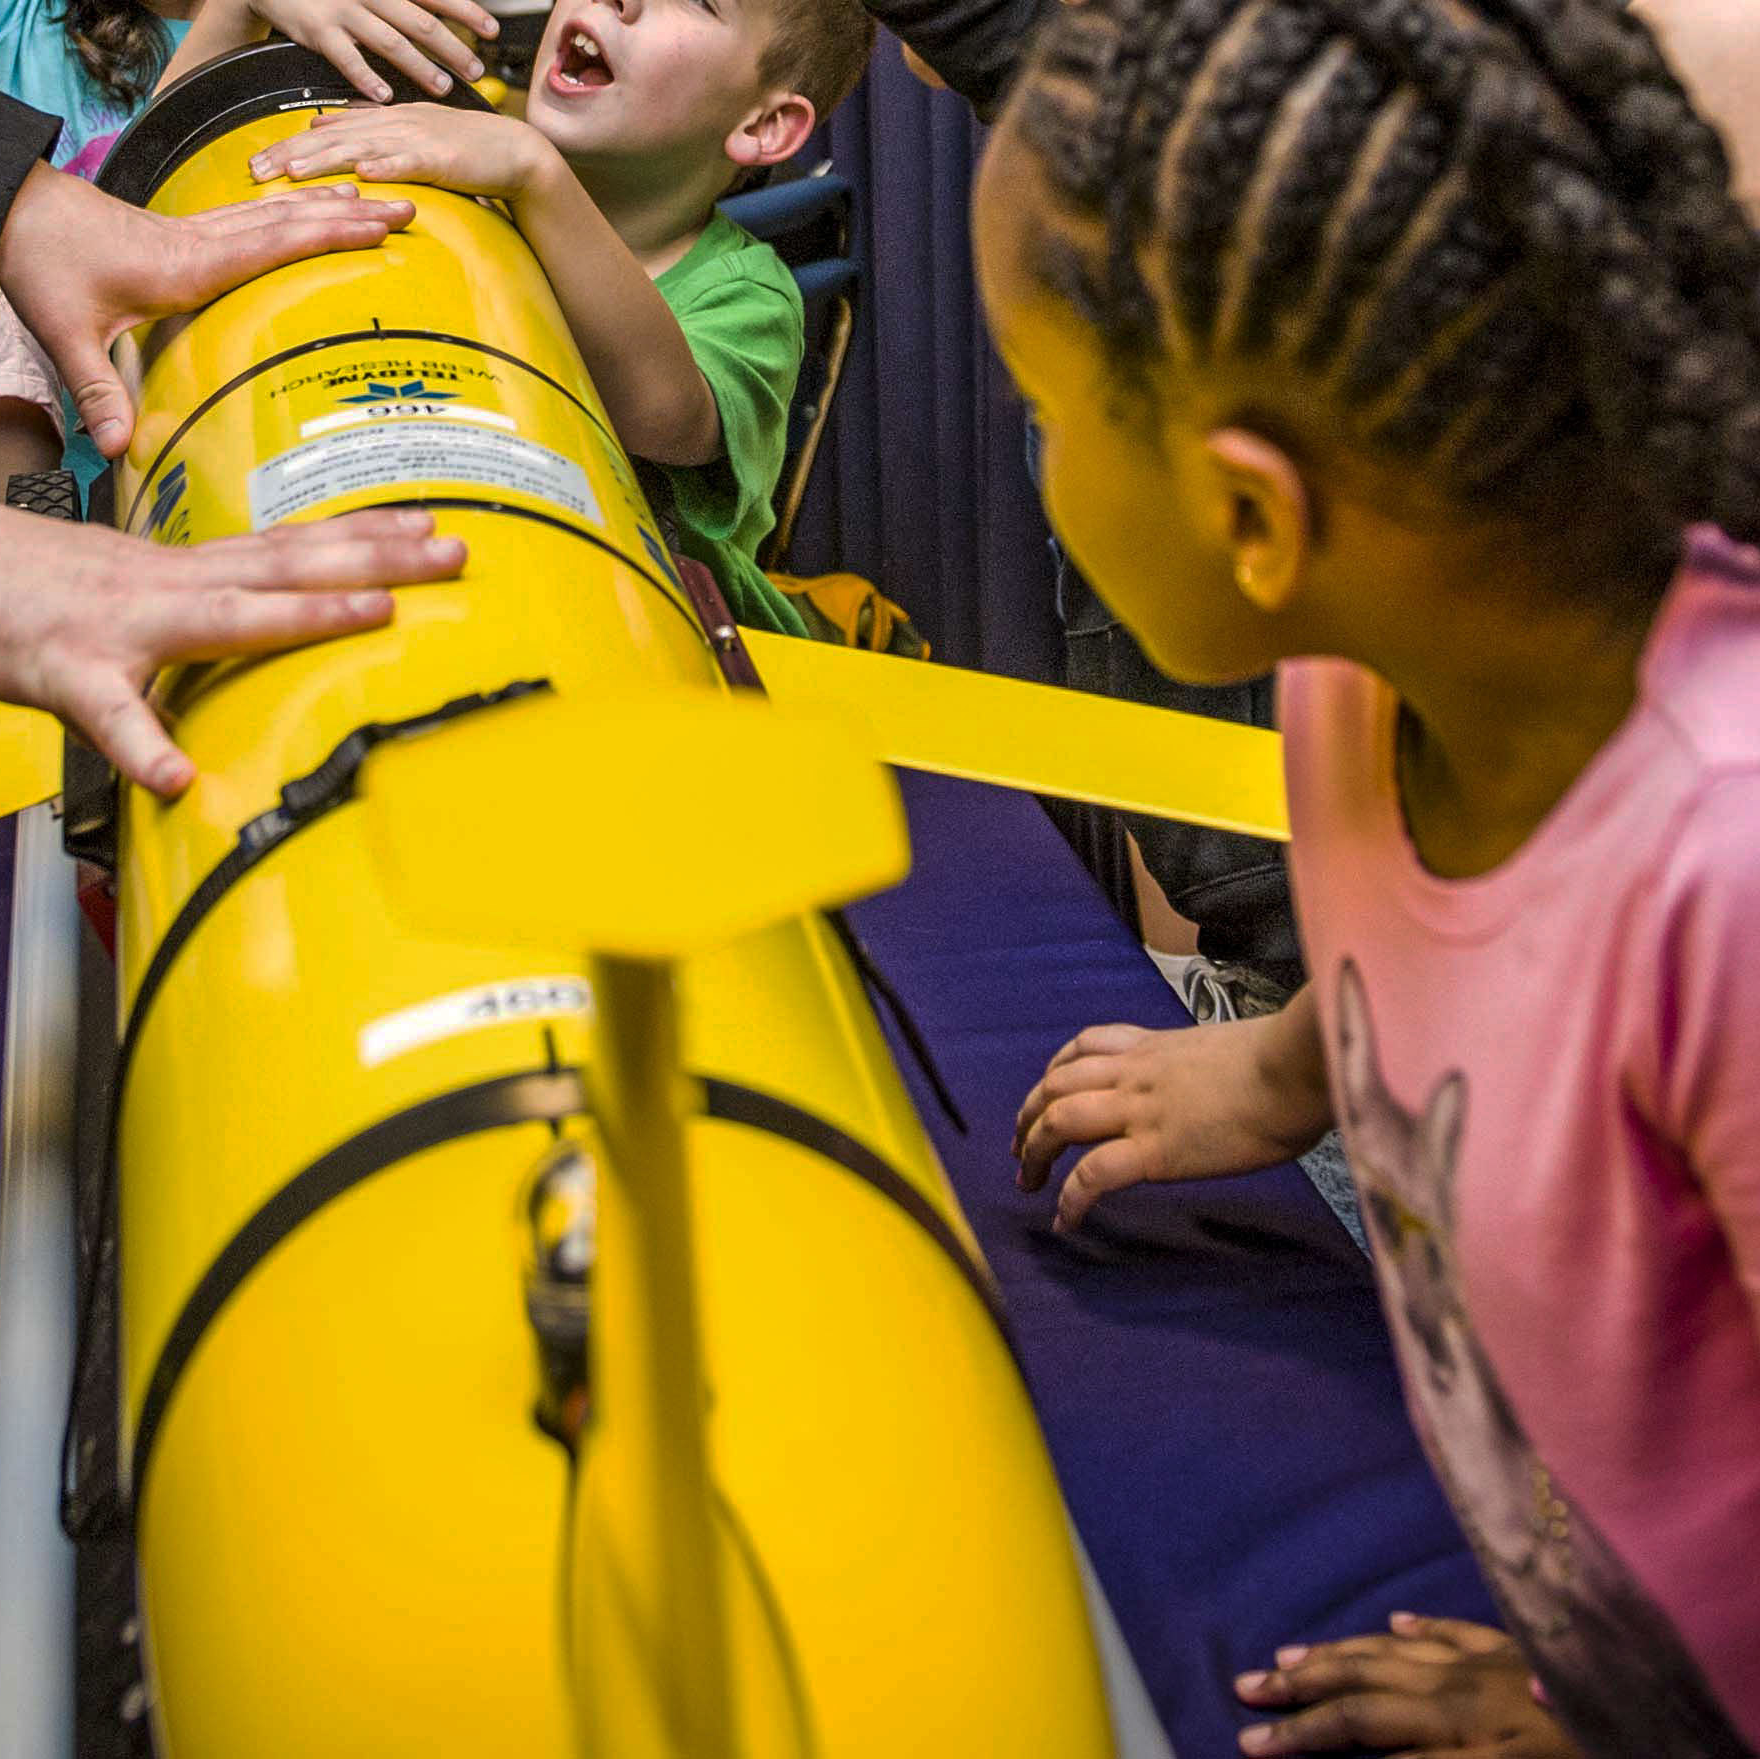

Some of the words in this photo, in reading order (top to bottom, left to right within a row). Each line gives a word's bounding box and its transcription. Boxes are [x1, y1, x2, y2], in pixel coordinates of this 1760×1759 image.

[269, 359, 412, 399] RESEARCH
[323, 369, 462, 389] TELEDYNE
[422, 360, 503, 383] WEBB
[367, 405, 447, 416] 466
